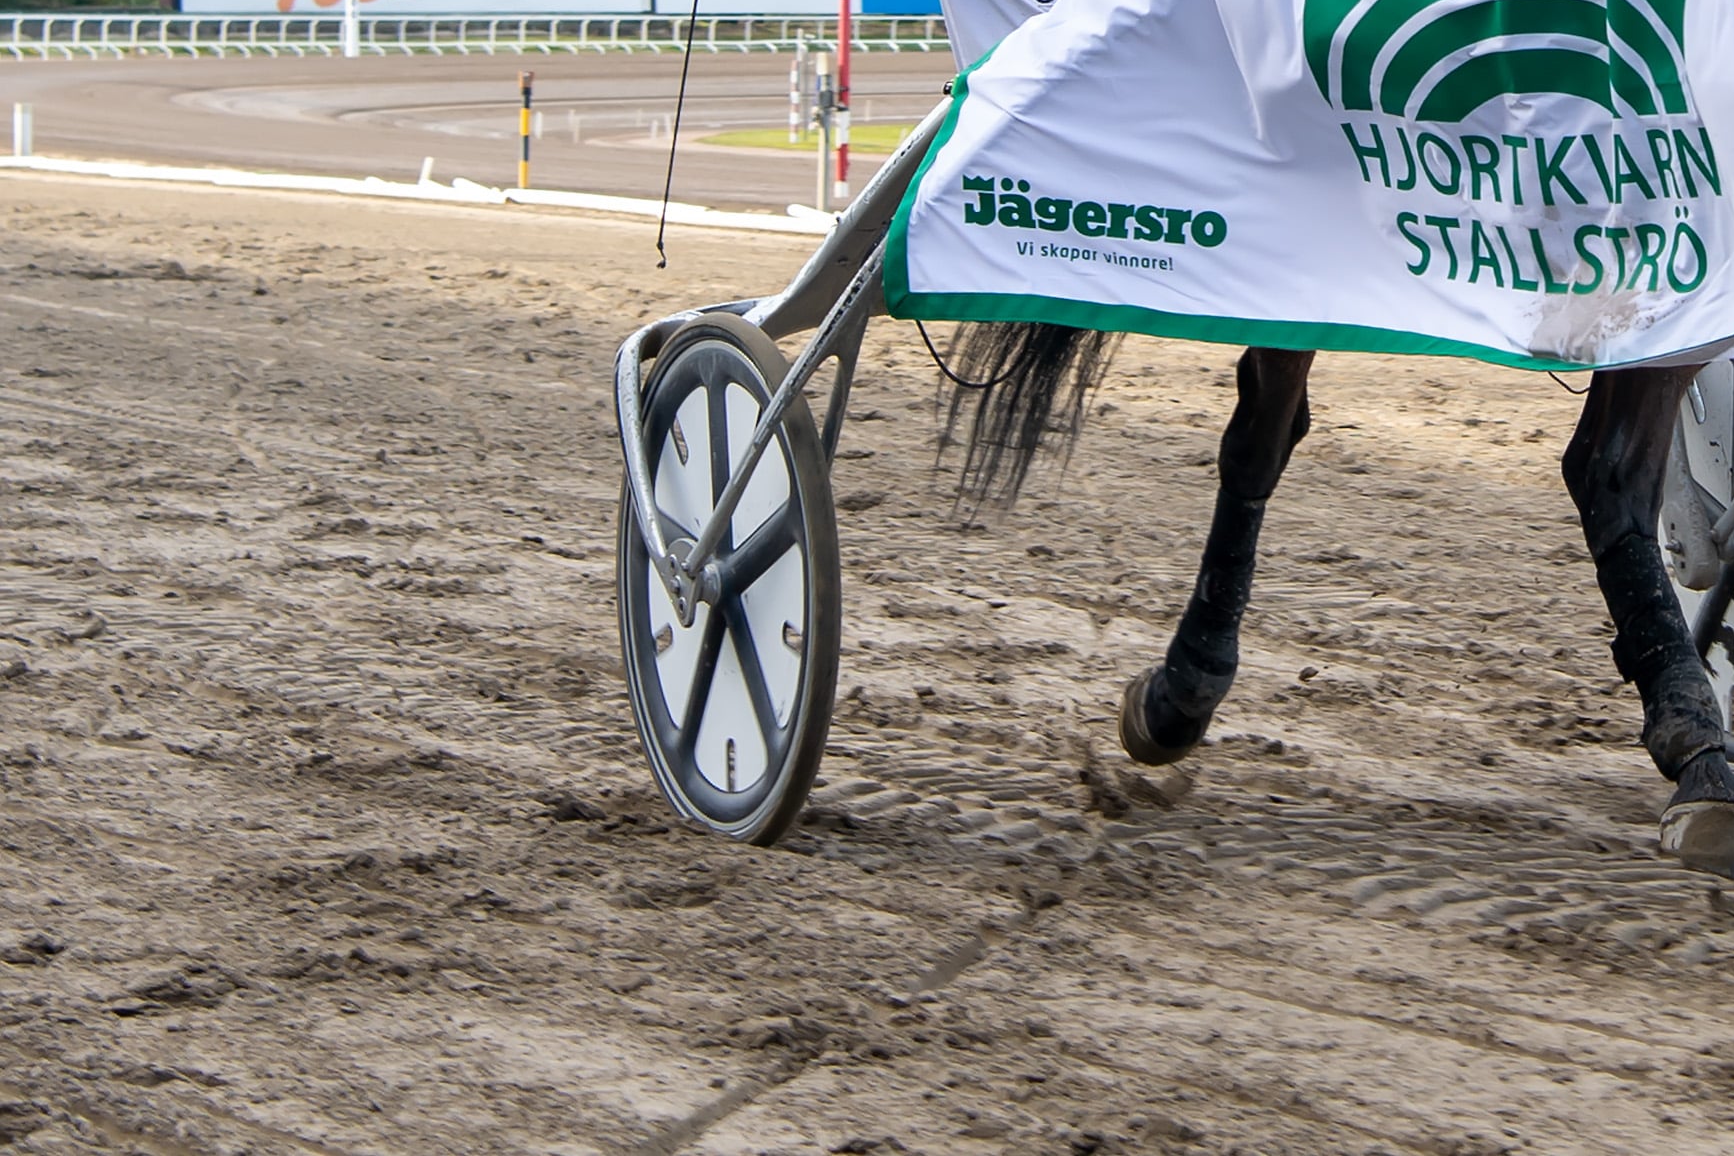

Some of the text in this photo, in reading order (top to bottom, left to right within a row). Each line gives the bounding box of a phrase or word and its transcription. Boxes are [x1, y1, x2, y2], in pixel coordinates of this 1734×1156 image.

[962, 174, 1228, 248] Jägersro
[1017, 241, 1174, 271] Vi skapar vinnare!
[1396, 206, 1708, 294] STALLSTRÖ
